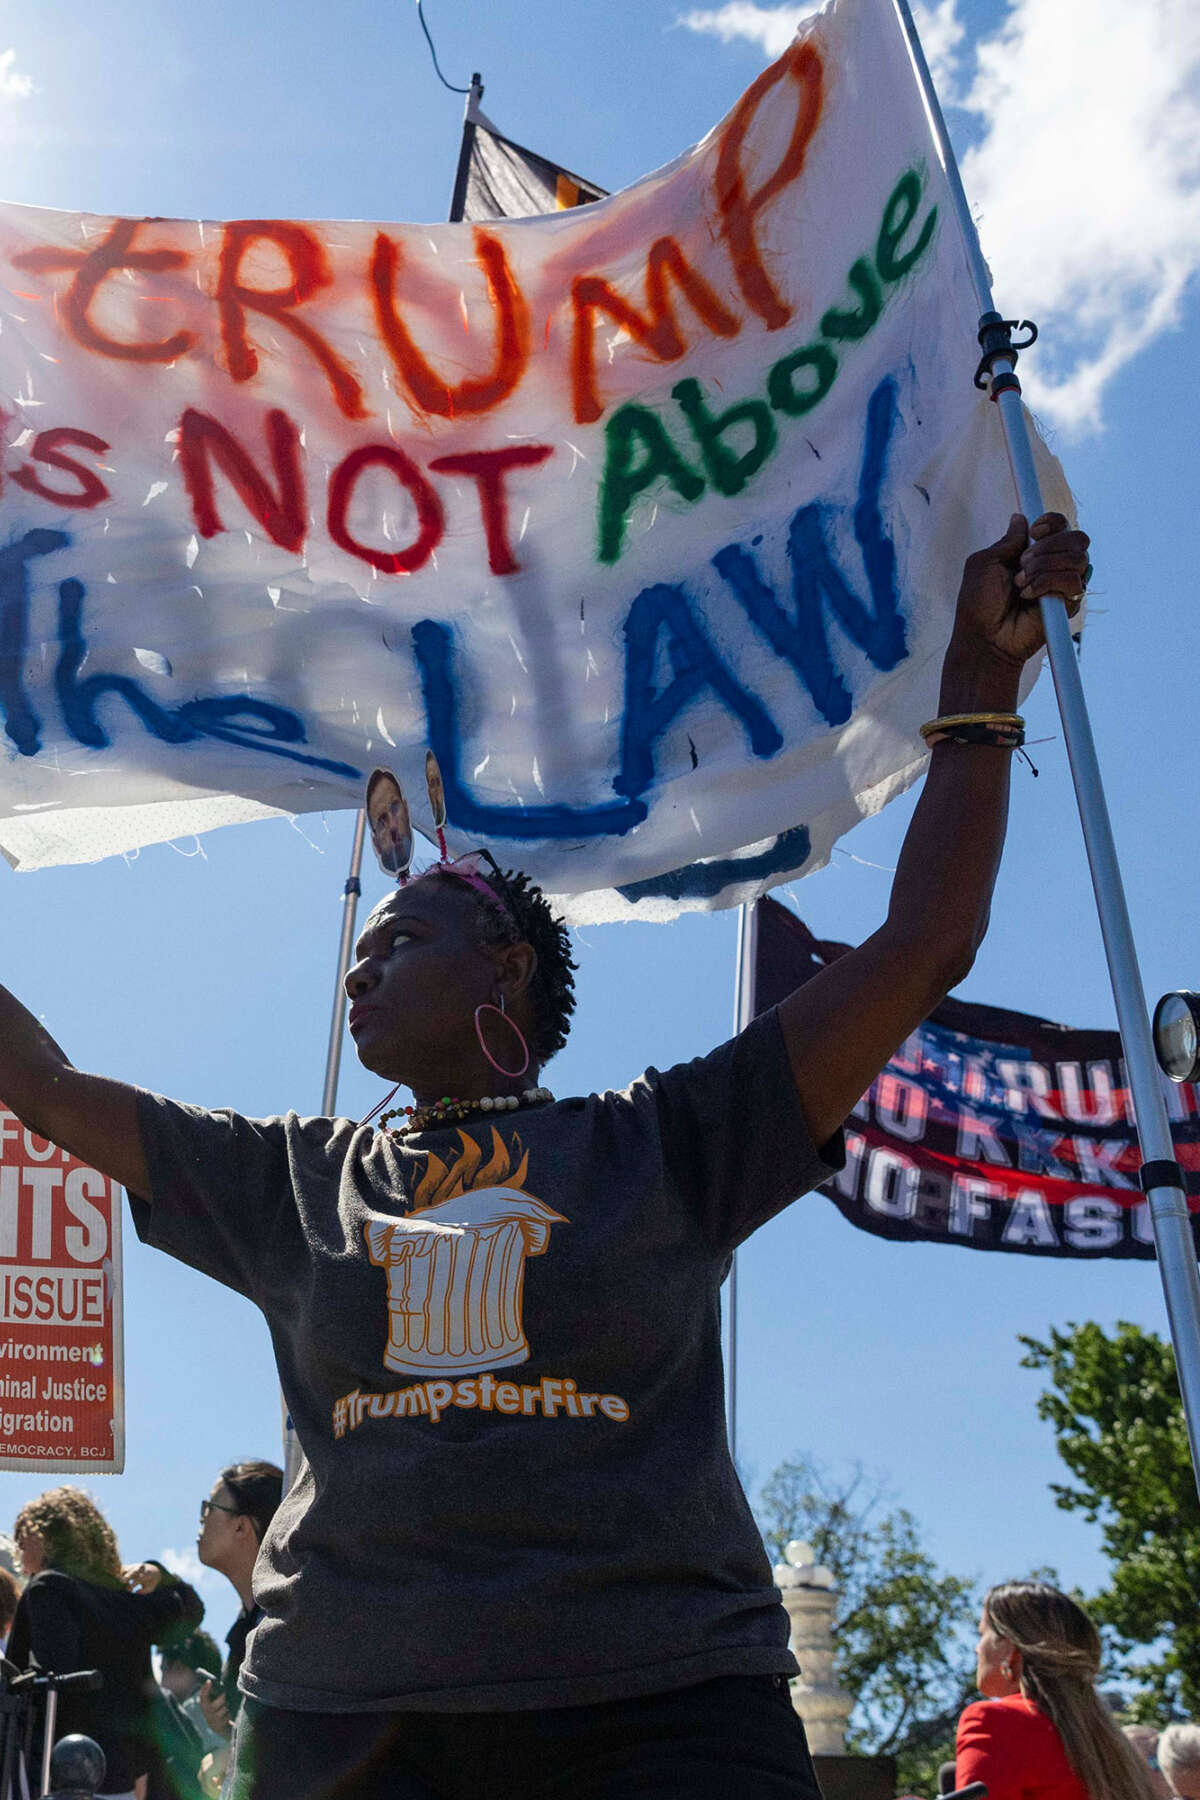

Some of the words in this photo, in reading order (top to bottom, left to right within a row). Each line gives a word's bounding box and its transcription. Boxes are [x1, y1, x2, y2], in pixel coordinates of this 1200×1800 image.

[176, 403, 555, 576] NOT
[410, 373, 910, 839] LAW
[942, 1050, 1200, 1130] TRU
[850, 1072, 929, 1144] O
[955, 1103, 1140, 1192] KKK
[3, 1273, 103, 1323] ISSUE
[42, 1376, 107, 1402] Justice
[332, 1373, 630, 1440] #TrumpsterFire
